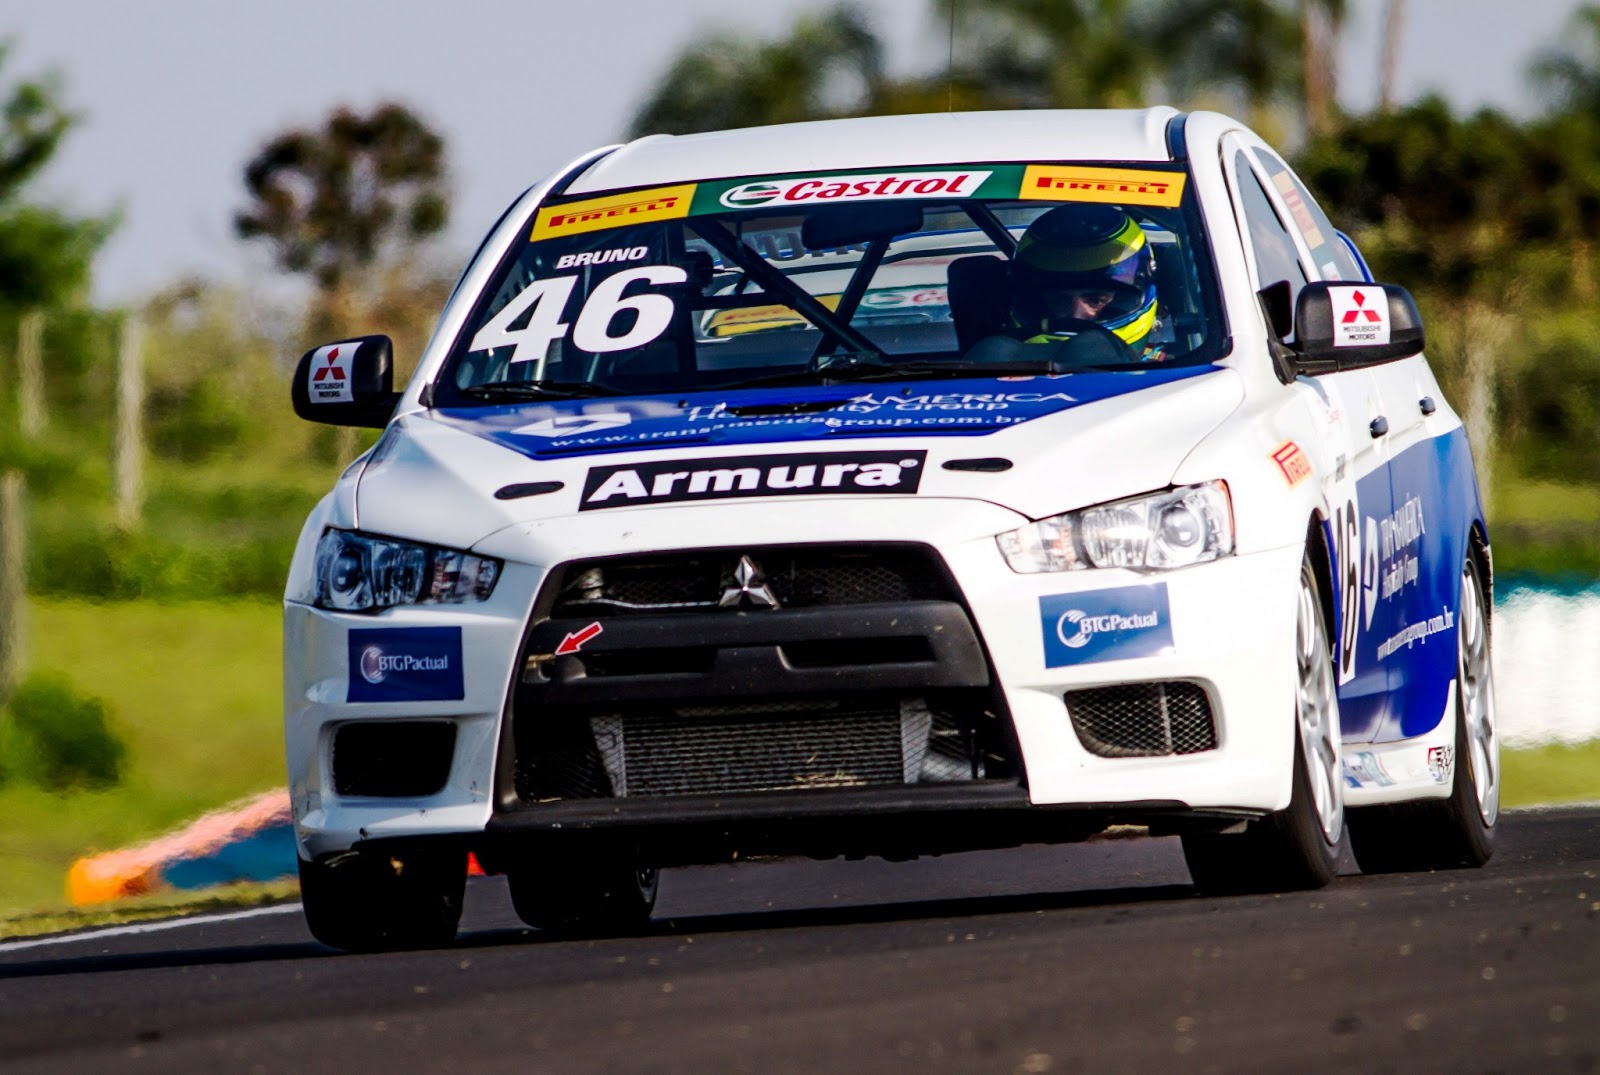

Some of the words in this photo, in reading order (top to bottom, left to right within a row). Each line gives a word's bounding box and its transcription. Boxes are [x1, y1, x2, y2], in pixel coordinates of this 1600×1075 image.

[783, 174, 970, 201] Castrol
[1036, 177, 1170, 195] PIRELLI
[548, 197, 679, 228] PIRELLI
[555, 246, 648, 269] BRUNO
[467, 265, 688, 364] 46
[1343, 325, 1382, 333] MITSUBISHI
[378, 654, 449, 672] BTGPactual
